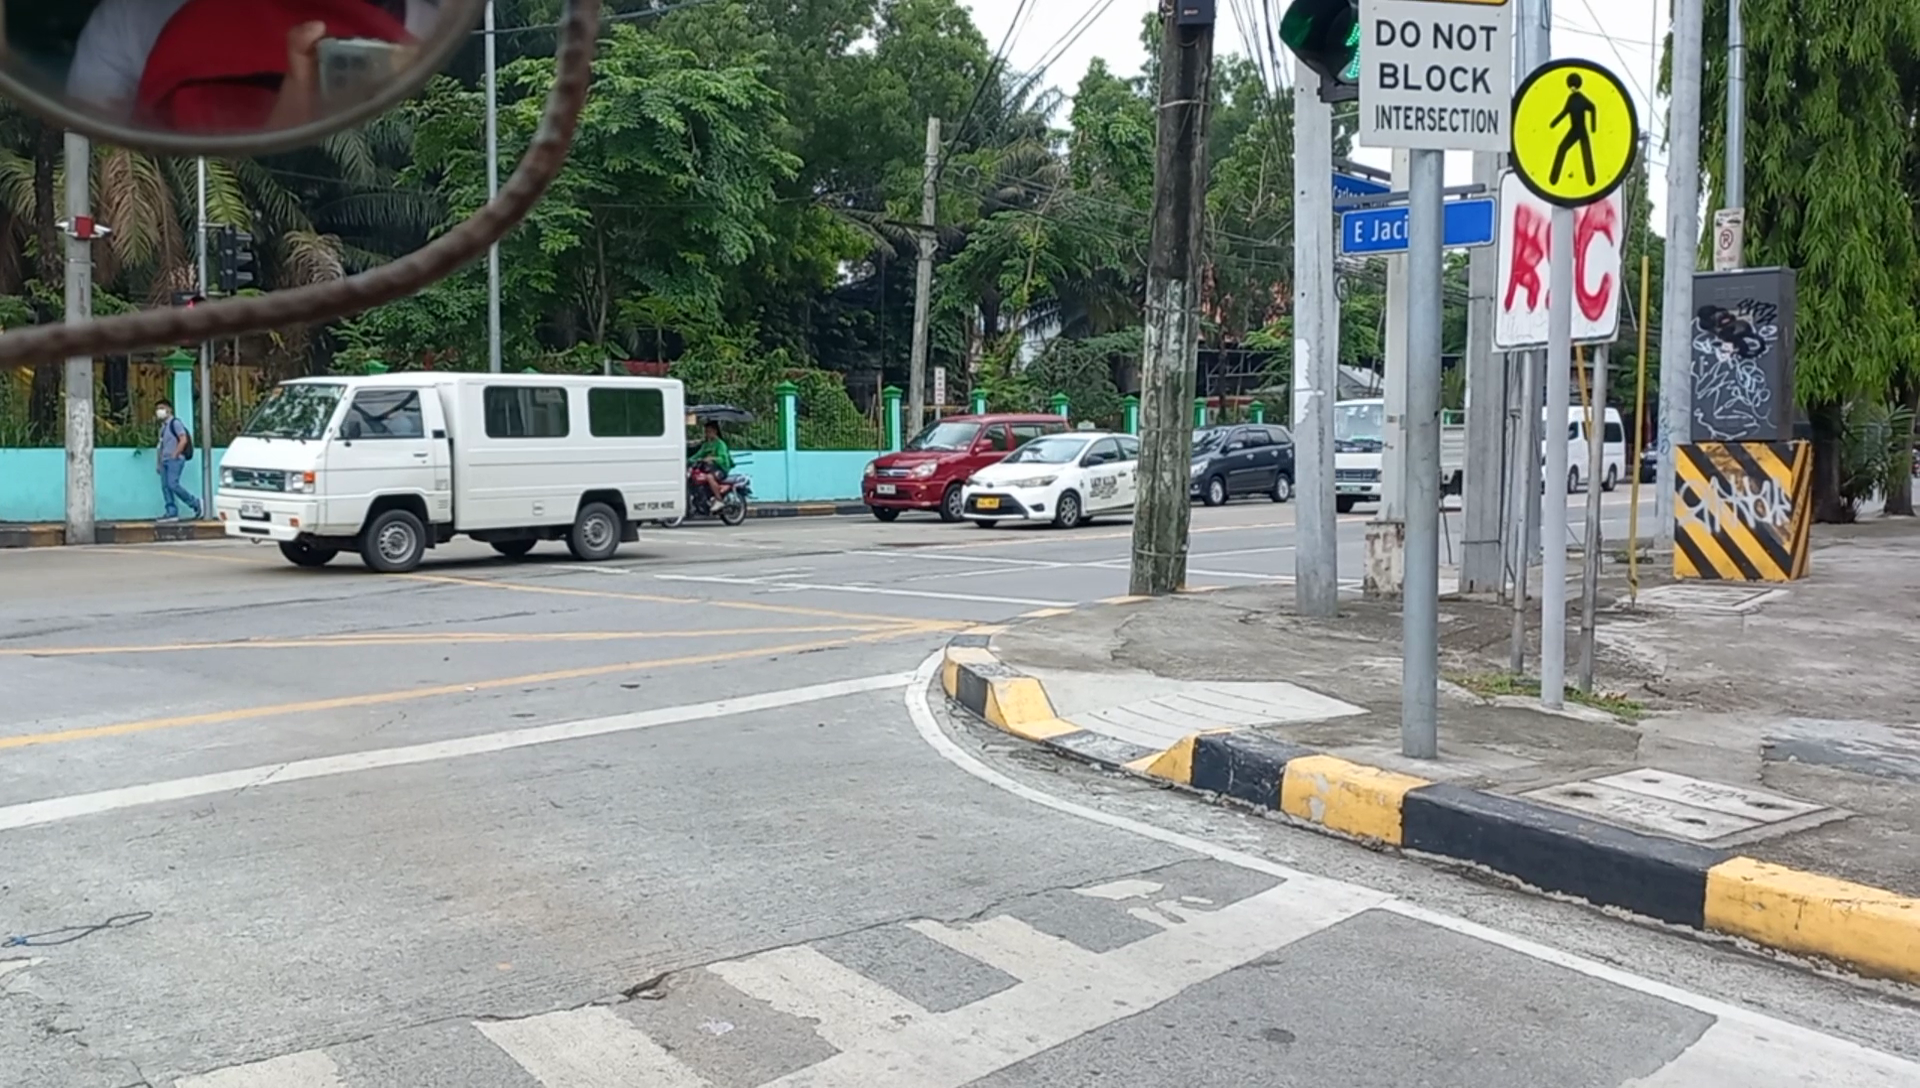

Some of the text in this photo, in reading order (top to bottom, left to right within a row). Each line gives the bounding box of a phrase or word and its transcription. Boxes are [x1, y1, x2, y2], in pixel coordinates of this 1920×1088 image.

[1376, 19, 1497, 52] DO NOT
[1379, 62, 1491, 94] BLOCK
[1375, 104, 1499, 135] INTERSECTION
[1354, 221, 1364, 243] E
